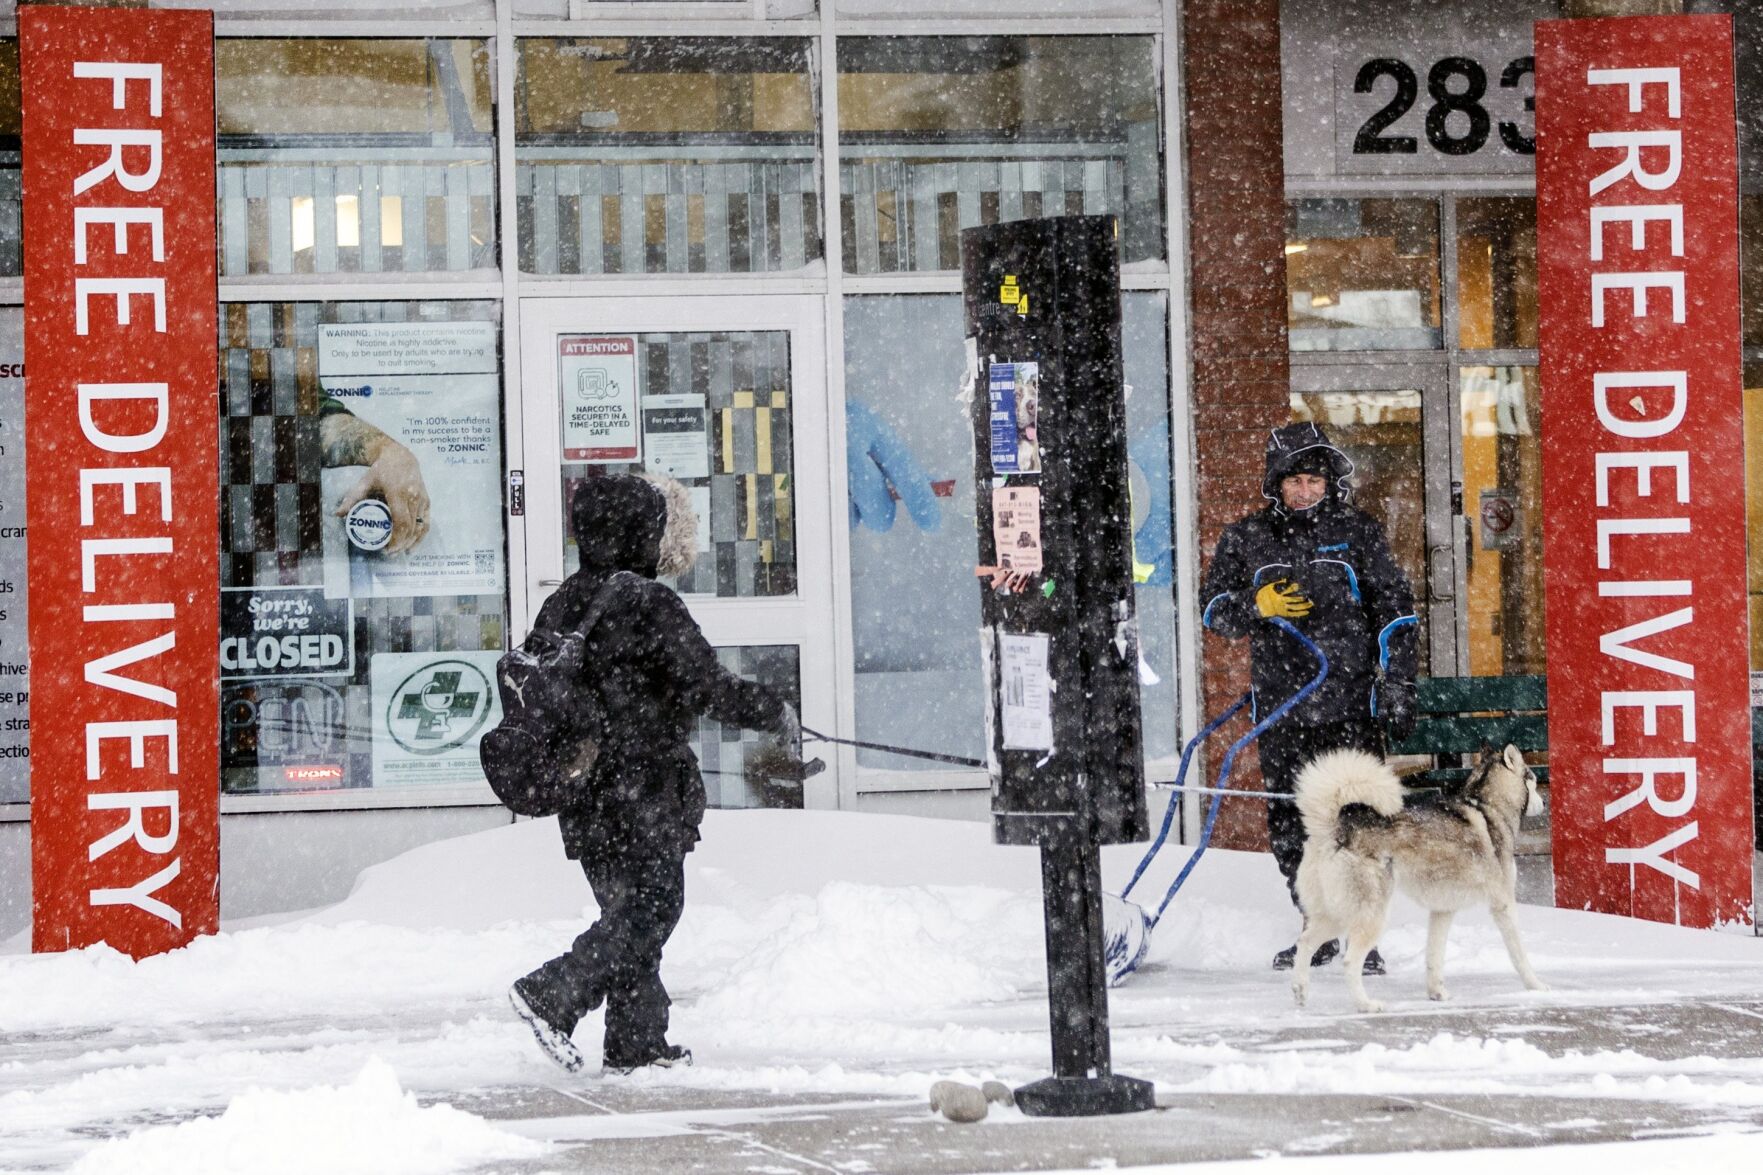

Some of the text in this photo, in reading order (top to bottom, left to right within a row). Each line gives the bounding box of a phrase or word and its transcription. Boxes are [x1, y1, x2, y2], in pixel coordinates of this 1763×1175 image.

[391, 329, 421, 339] product
[356, 339, 389, 348] Nicotine
[398, 338, 421, 348] highly
[566, 342, 628, 353] ATTENTION
[331, 350, 349, 359] Only
[351, 350, 360, 358] to
[361, 349, 371, 358] be
[373, 349, 392, 357] used
[393, 349, 403, 358] by
[430, 348, 446, 356] who
[378, 359, 386, 367] to
[387, 359, 402, 368] quit
[326, 385, 373, 397] ZONNIC
[575, 405, 623, 413] NARCOTICS
[425, 417, 449, 426] 100%
[451, 415, 491, 425] confident
[571, 413, 610, 421] SECURED
[611, 412, 620, 420] IN
[651, 412, 698, 425] For your safety
[568, 420, 631, 429] TIME-DELAYED
[402, 427, 410, 435] in
[412, 428, 424, 436] my
[427, 427, 459, 435] success
[461, 426, 470, 434] to
[472, 426, 483, 434] be
[589, 428, 610, 436] SAFE
[410, 435, 492, 444] non-smoker thanks
[437, 445, 446, 453] to
[1586, 66, 1701, 890] FREE DELIVERY
[73, 61, 182, 930] FREE DELIVERY
[349, 517, 392, 530] ZONNIC
[247, 596, 313, 615] Sorry,
[253, 614, 310, 631] we're
[220, 634, 344, 670] CLOSED
[0, 661, 29, 676] hive
[224, 696, 332, 752] PEN
